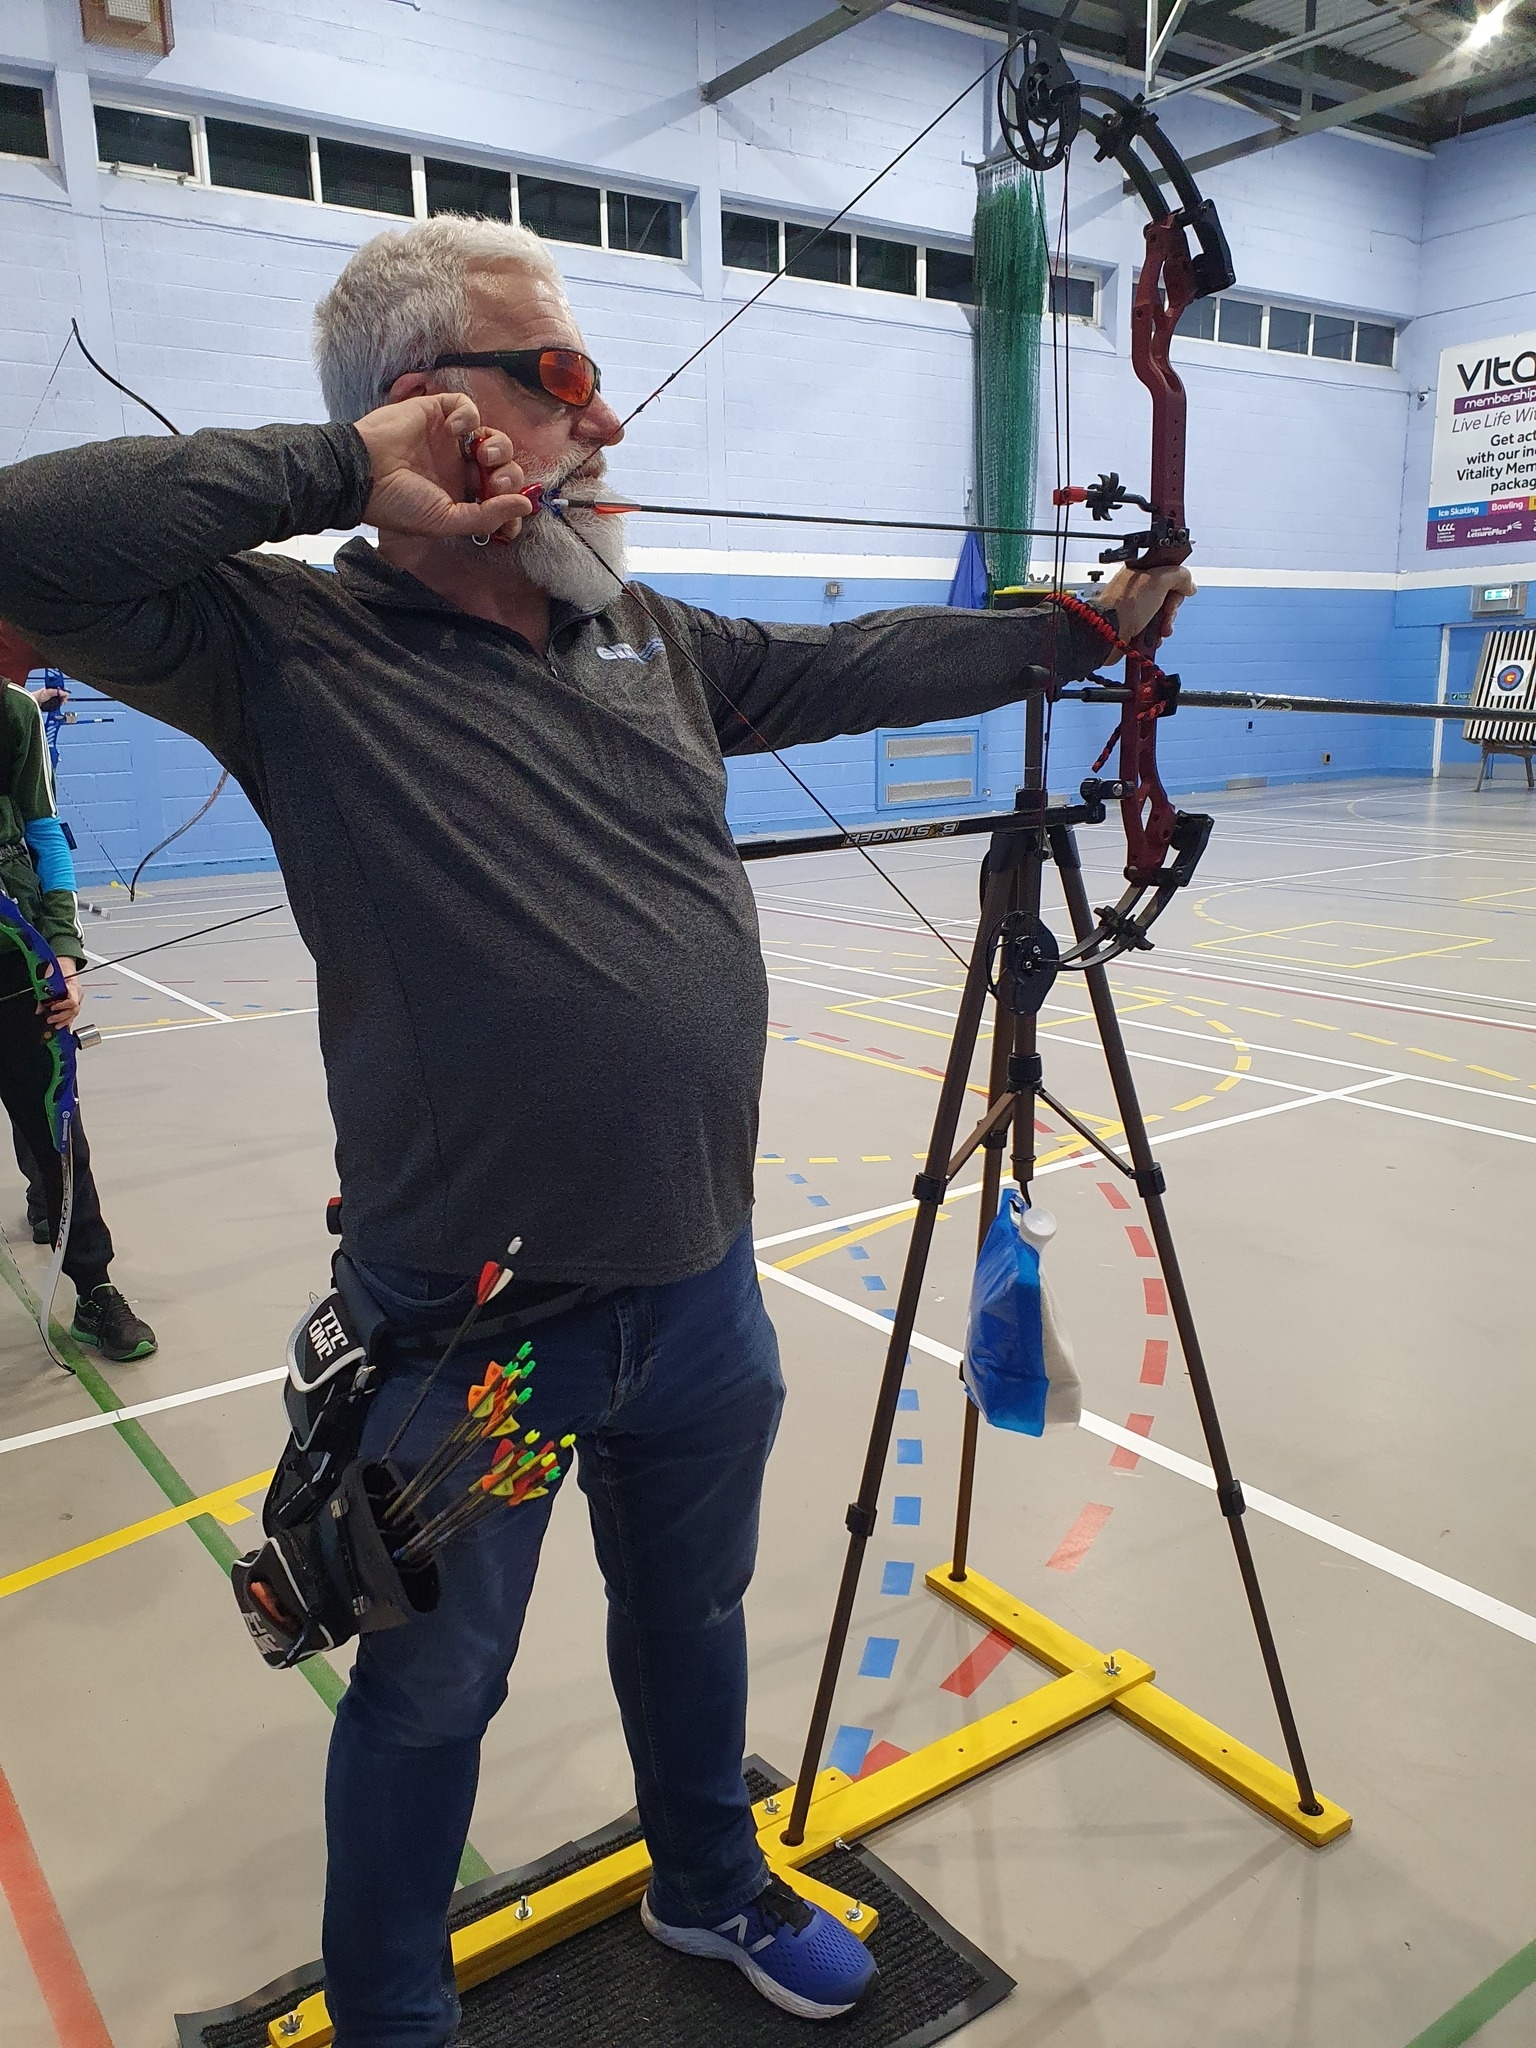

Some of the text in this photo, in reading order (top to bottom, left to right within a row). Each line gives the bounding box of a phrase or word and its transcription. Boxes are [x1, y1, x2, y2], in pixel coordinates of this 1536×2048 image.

[1452, 418, 1481, 433] Live
[1484, 411, 1511, 428] Life
[1490, 433, 1514, 447] Get
[1466, 446, 1536, 465] with our in
[1457, 466, 1503, 481] Vitality
[1438, 506, 1479, 517] Ice Skating
[1491, 501, 1524, 511] Bowling
